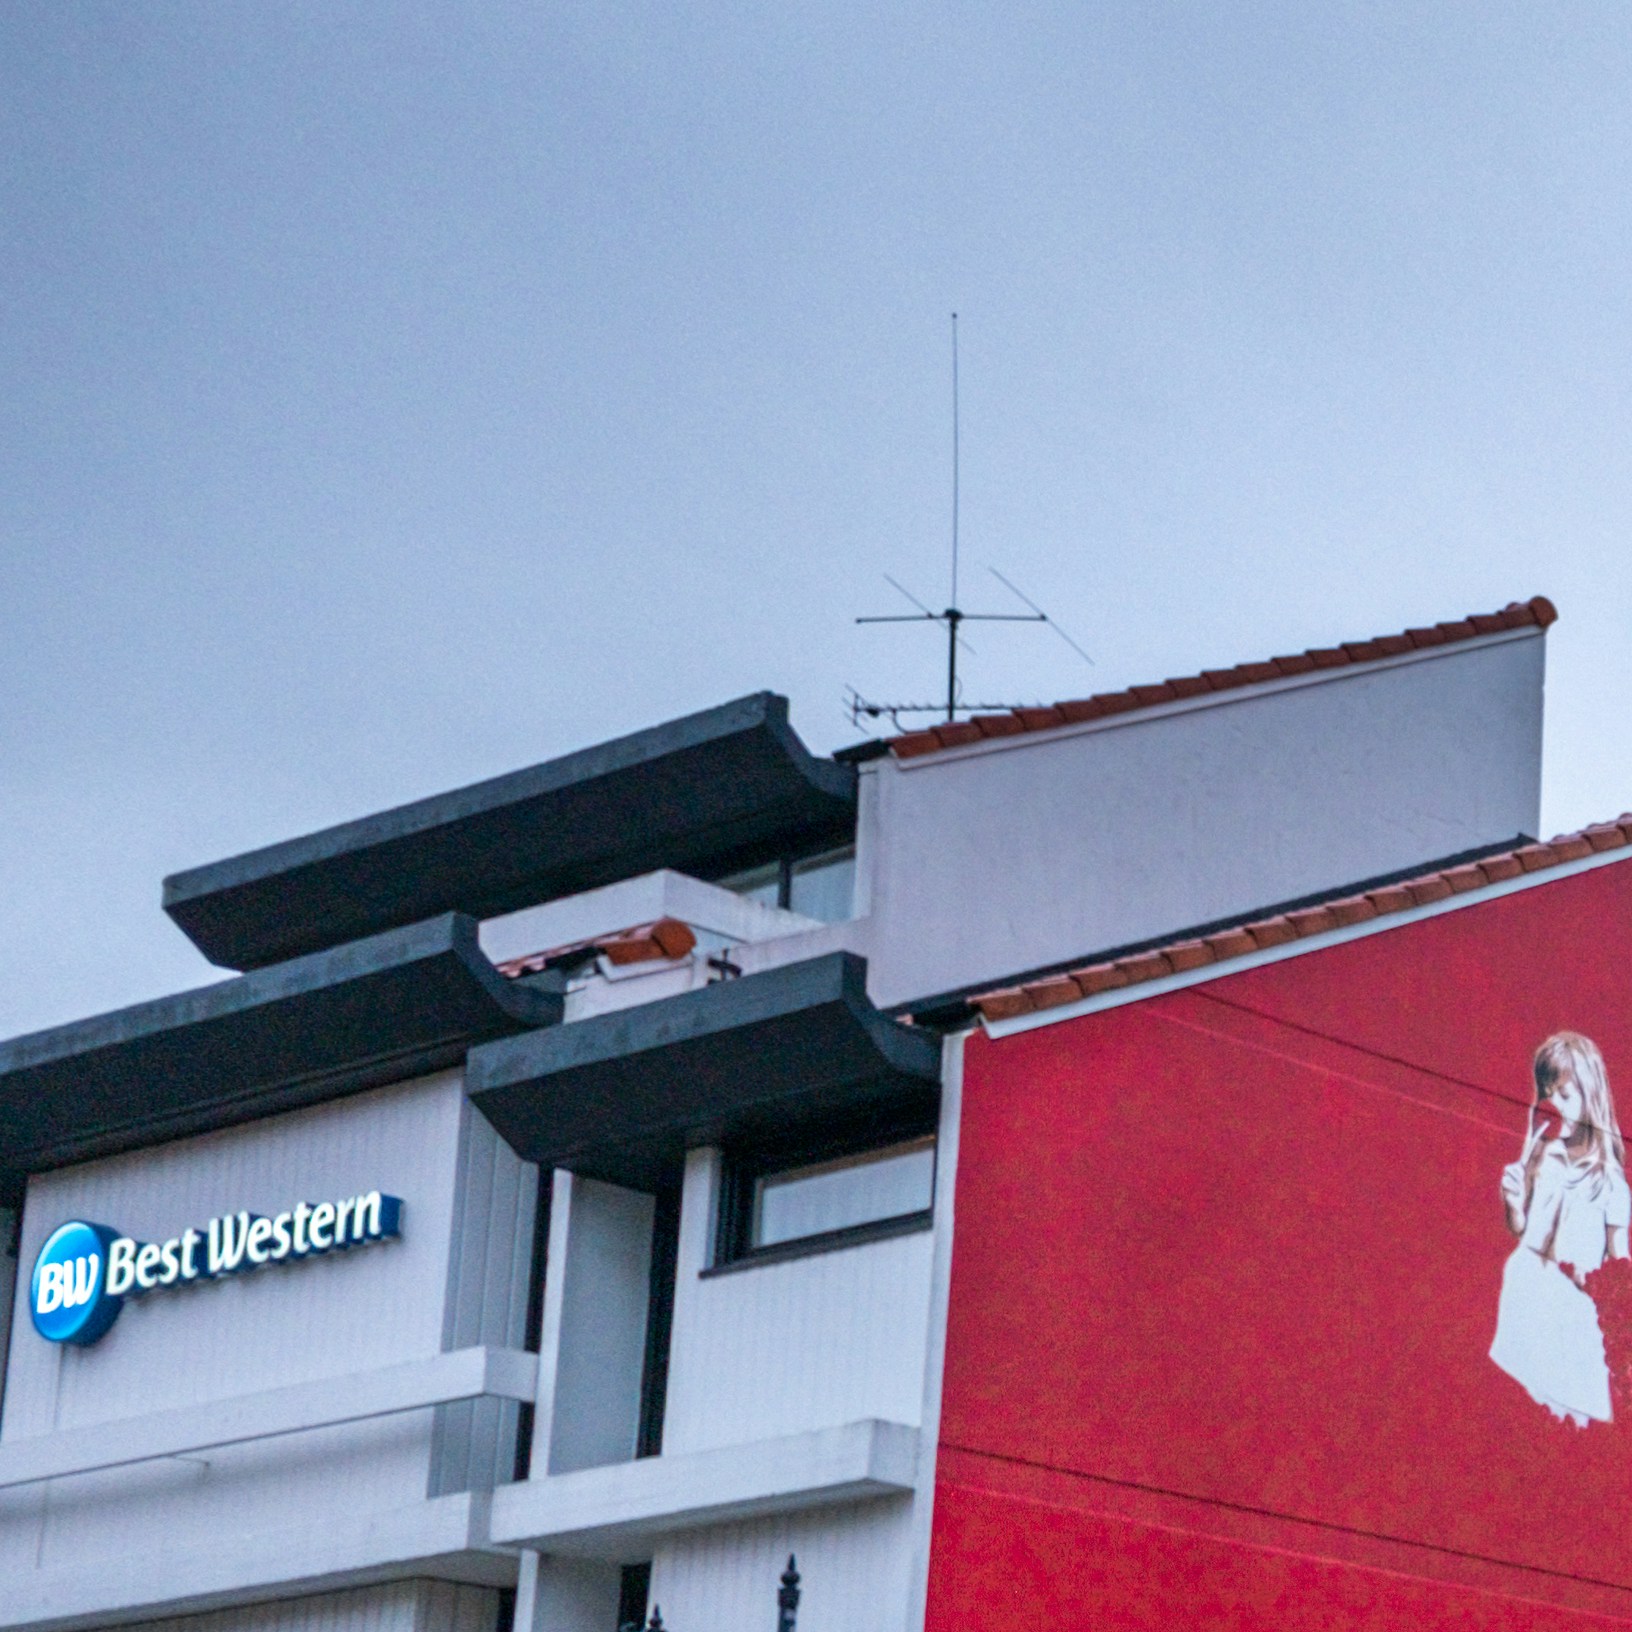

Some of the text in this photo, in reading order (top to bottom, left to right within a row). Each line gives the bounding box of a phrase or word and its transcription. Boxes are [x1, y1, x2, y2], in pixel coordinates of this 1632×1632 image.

[36, 1252, 99, 1314] BW
[106, 1190, 382, 1295] Best Western
